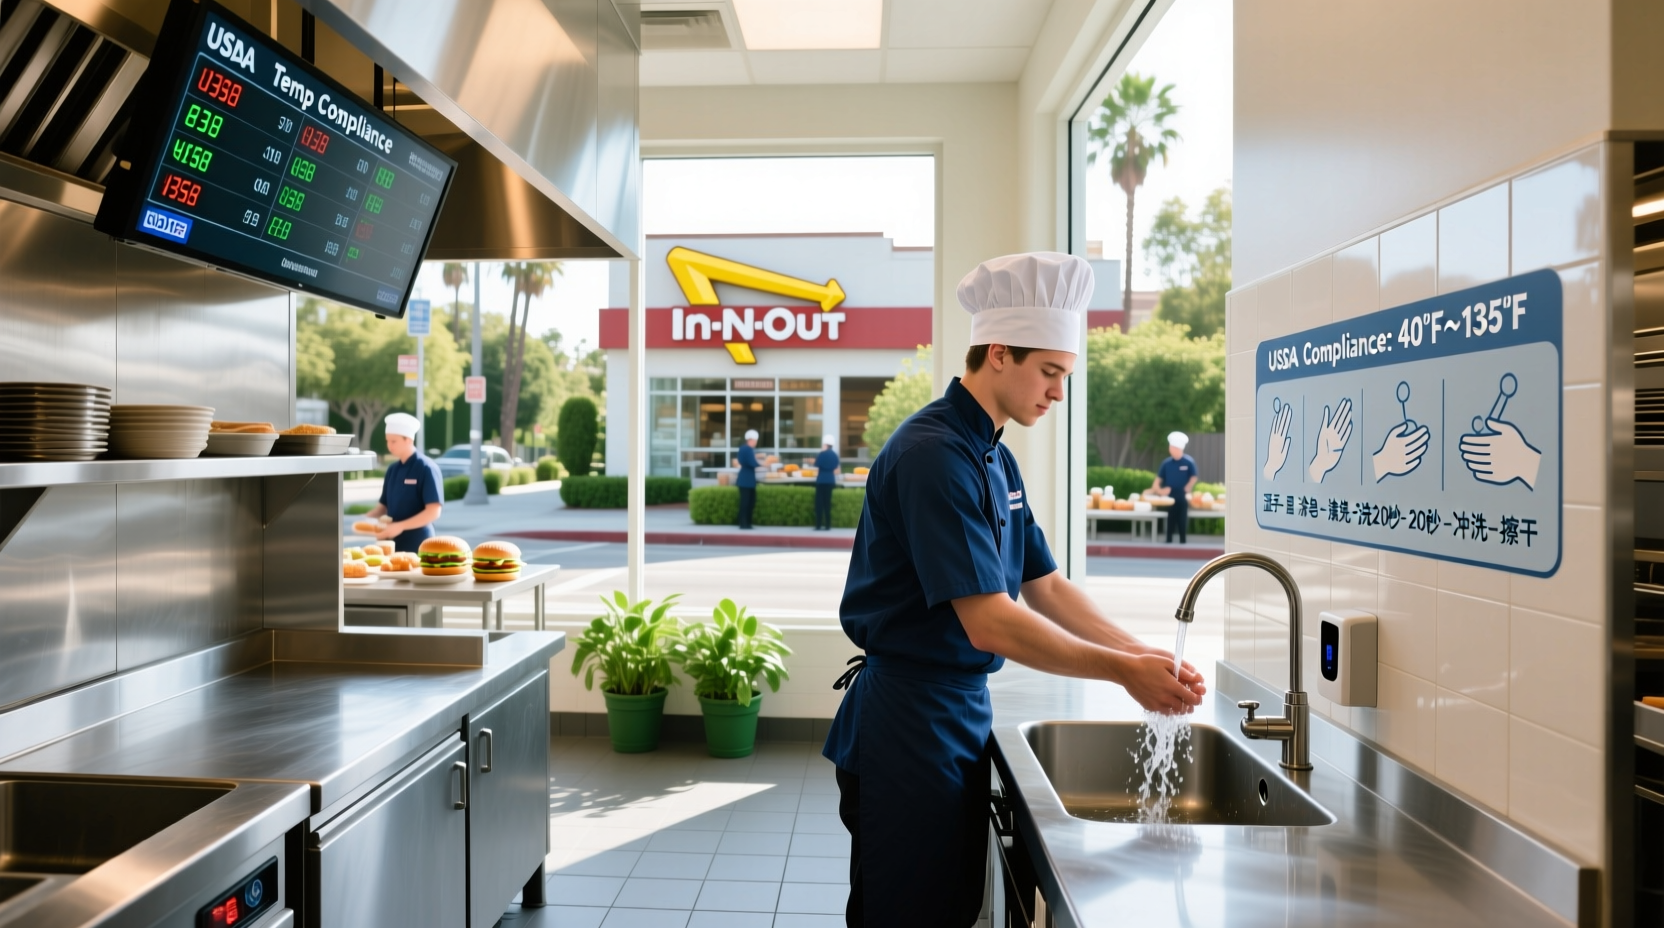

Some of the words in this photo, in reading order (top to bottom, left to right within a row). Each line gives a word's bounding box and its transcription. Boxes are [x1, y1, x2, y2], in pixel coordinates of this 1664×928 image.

[273, 61, 314, 110] Temp
[184, 104, 224, 138] 838
[161, 174, 201, 206] 1358
[1303, 332, 1392, 367] Compliance:
